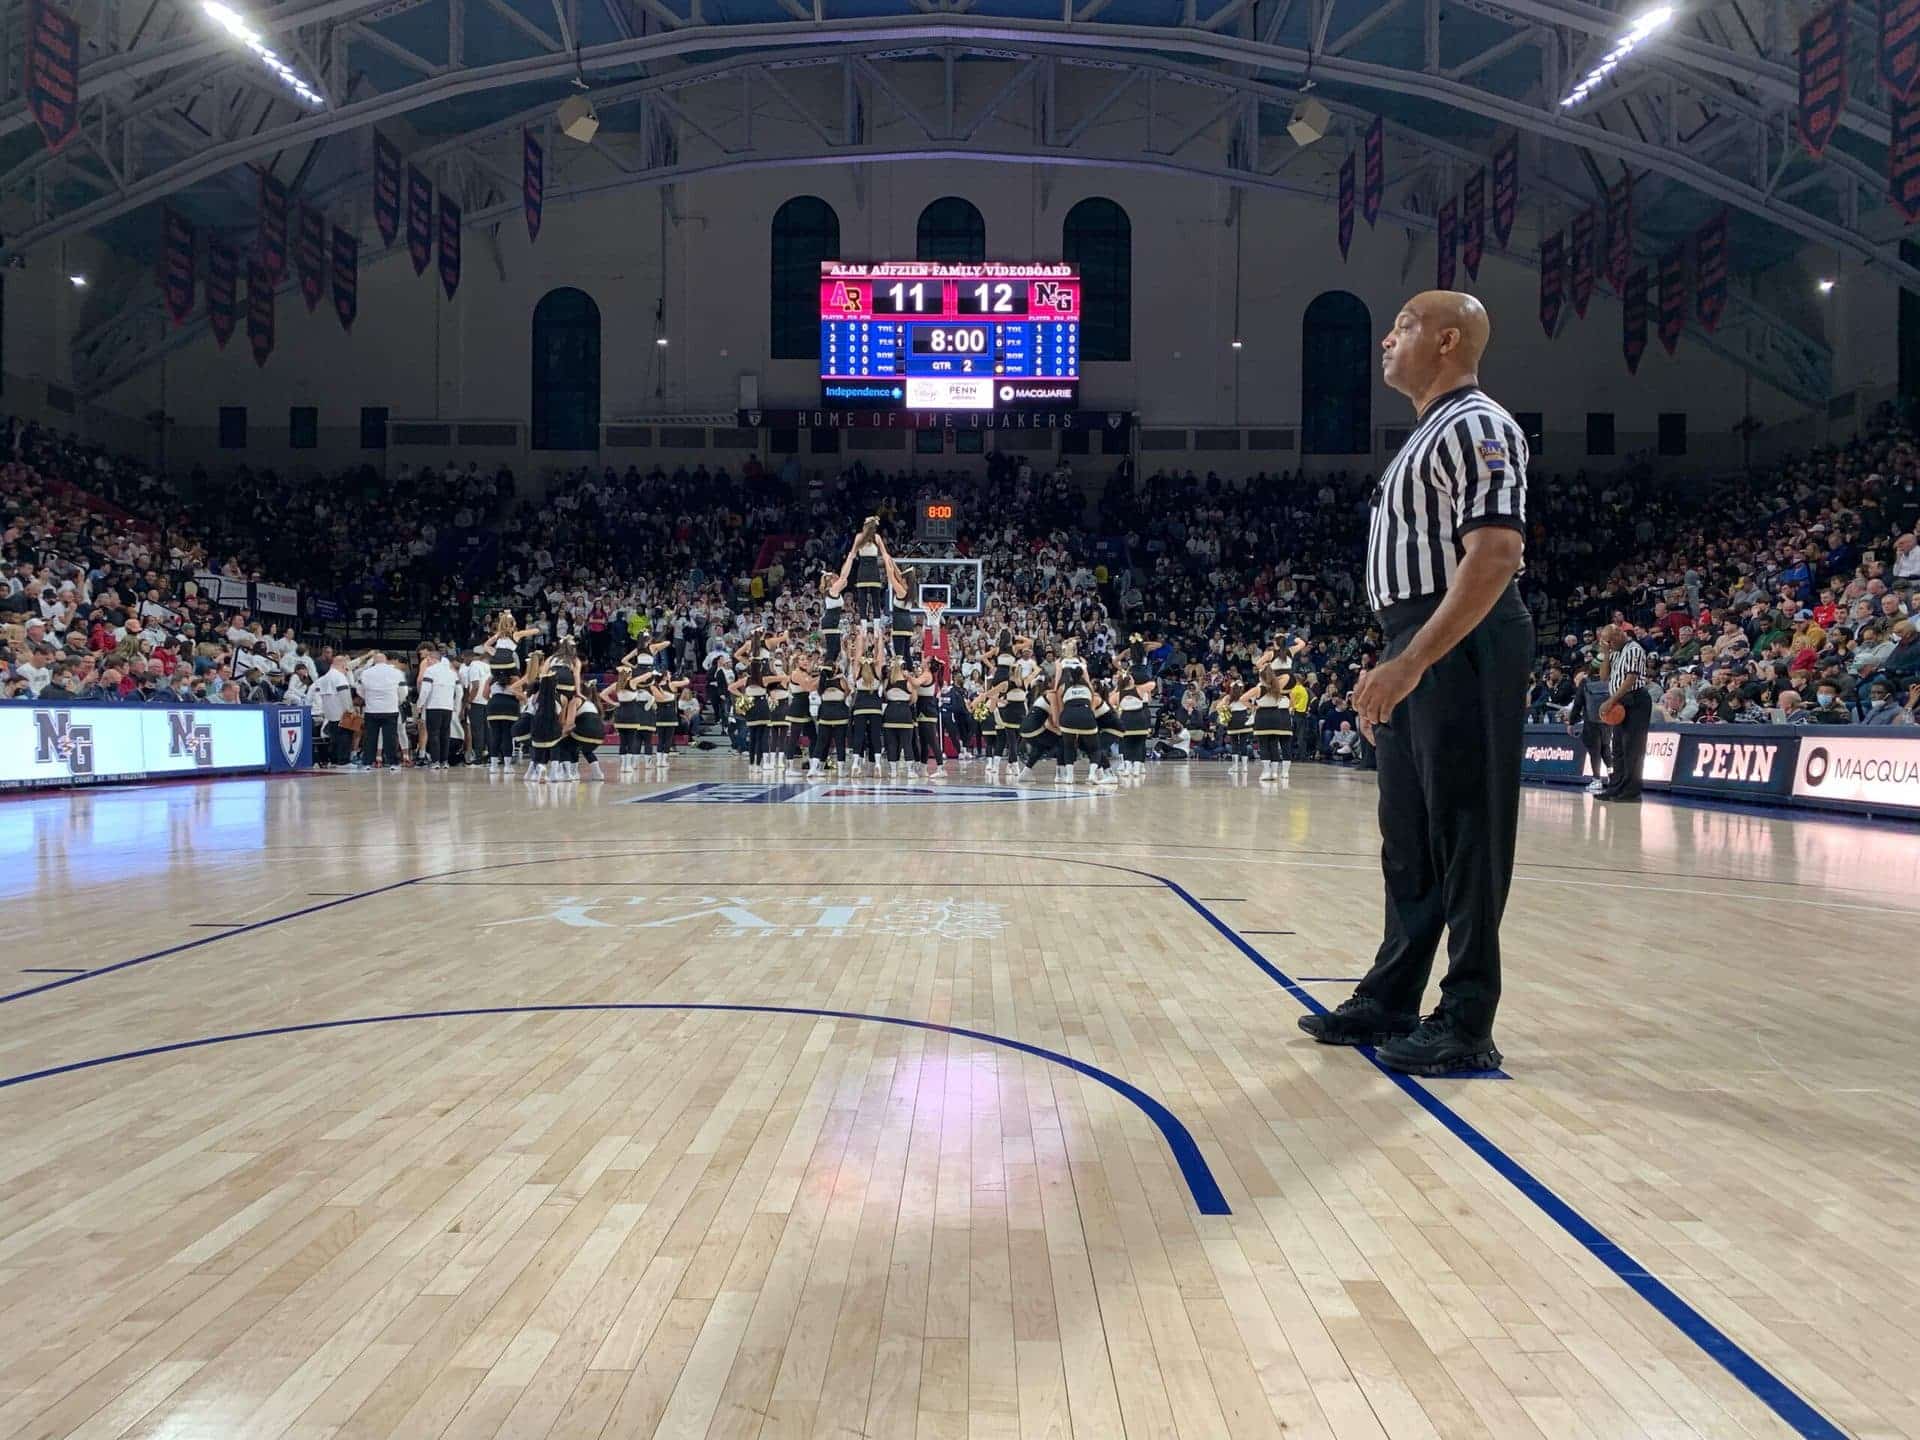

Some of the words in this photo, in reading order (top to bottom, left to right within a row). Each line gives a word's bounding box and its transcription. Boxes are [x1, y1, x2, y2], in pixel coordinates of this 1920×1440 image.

[831, 265, 867, 275] ALAN
[871, 265, 928, 276] AUFZIEN
[932, 265, 983, 276] FAMILY
[986, 265, 1071, 276] VIDEOBOARD
[889, 282, 924, 312] 11
[974, 283, 1013, 312] 12
[862, 323, 869, 331] 0
[896, 325, 903, 333] 4
[862, 334, 869, 342] 0
[897, 339, 903, 347] 1
[931, 329, 985, 352] 8:00
[862, 345, 869, 353] 0
[862, 356, 869, 364] 0
[862, 367, 869, 375] 0
[932, 361, 952, 370] QTR
[962, 360, 972, 372] 2
[826, 387, 890, 398] Independence
[949, 386, 977, 394] PENN
[1015, 389, 1072, 398] MACQUARIE
[798, 411, 855, 426] HOME
[873, 412, 896, 426] OF
[914, 412, 952, 427] THE
[971, 413, 1073, 427] QUAKERS
[928, 506, 952, 518] 8:00
[281, 712, 301, 723] PENN
[33, 710, 93, 775] NG
[167, 711, 213, 768] NG
[1525, 746, 1574, 762] #FightOnPenn
[1692, 742, 1778, 783] PENN
[1834, 757, 1920, 784] MACQUA
